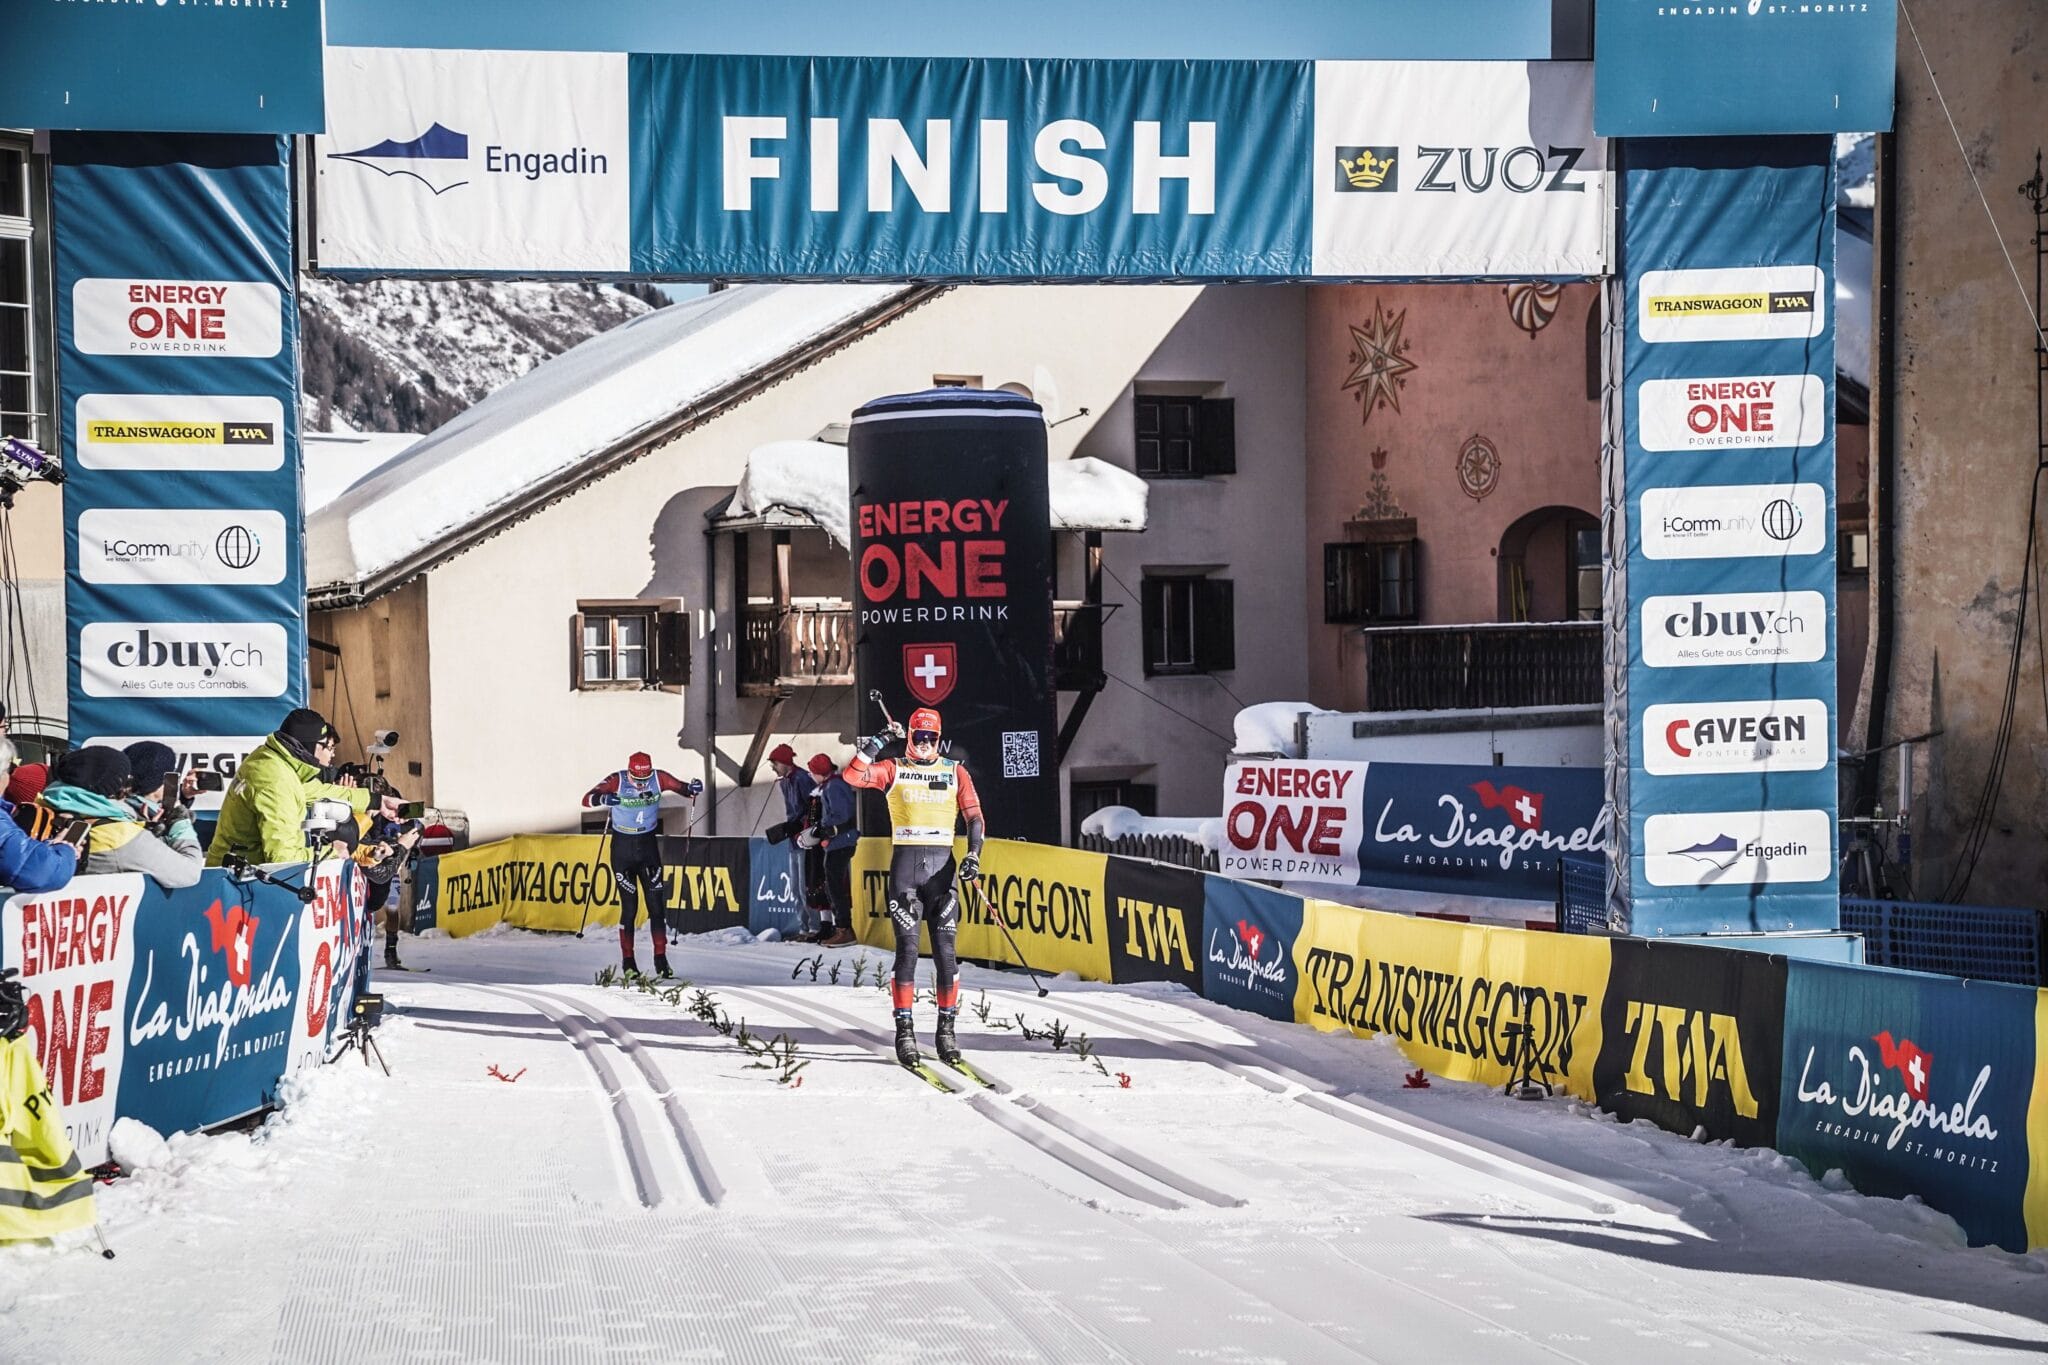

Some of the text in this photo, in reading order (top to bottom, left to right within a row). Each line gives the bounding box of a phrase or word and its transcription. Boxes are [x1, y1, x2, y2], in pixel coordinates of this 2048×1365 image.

[1658, 4, 1868, 15] ENGADIN ST.MORITZ
[486, 145, 608, 181] Engadin
[722, 115, 1217, 216] FINISH
[1414, 144, 1587, 194] ZUOZ
[128, 284, 228, 305] ENERGY
[1654, 296, 1809, 313] TRANSWAGGON TWA
[128, 306, 226, 340] ONE
[130, 342, 227, 352] POWERDRINK
[1687, 380, 1776, 401] ENERGY
[94, 426, 268, 440] TRANSWAGGON TWA
[1687, 402, 1774, 434] ONE
[15, 448, 38, 464] LYNX
[1688, 435, 1775, 446] POWERDRINK
[858, 498, 1009, 538] ENERGY
[1663, 516, 1756, 534] i-Community
[104, 540, 209, 560] i-Community
[860, 540, 1007, 603] ONE
[861, 605, 1009, 625] POWERDRINK
[1665, 601, 1804, 645] cbuy.ch
[107, 629, 263, 679] cbuy.ch
[1677, 649, 1700, 659] Alles
[1702, 649, 1725, 658] Gute
[1726, 649, 1743, 657] aus
[121, 680, 249, 690] Alles Gute aus Cannabis.
[1665, 715, 1806, 758] CAVEGN
[1697, 747, 1807, 758] PONTRESINA AG
[898, 772, 923, 781] WATCH
[923, 774, 940, 782] LIVE
[1236, 766, 1354, 800] ENERGY
[635, 810, 644, 825] 4
[1227, 800, 1348, 857] ONE
[1375, 793, 1610, 870] La Diagonel
[1225, 856, 1344, 878] POWERDRINK
[1404, 854, 1488, 867] ENGADIN
[1745, 841, 1807, 861] Engadin
[661, 865, 739, 913] TWA
[22, 895, 130, 977] ENERGY
[1117, 896, 1194, 972] TWA
[1209, 927, 1286, 990] La Diagonela
[131, 949, 173, 1047] La
[176, 914, 292, 1071] Diagonela
[1305, 946, 1588, 1077] TRANSWAGGON
[149, 1053, 210, 1083] ENGADIN
[222, 1030, 286, 1063] ST.MORITZ
[1624, 1000, 1759, 1119] TWA
[1797, 1045, 1998, 1151] La Diagonela
[1815, 1120, 2000, 1174] ENGADIN ST.MORITZ
